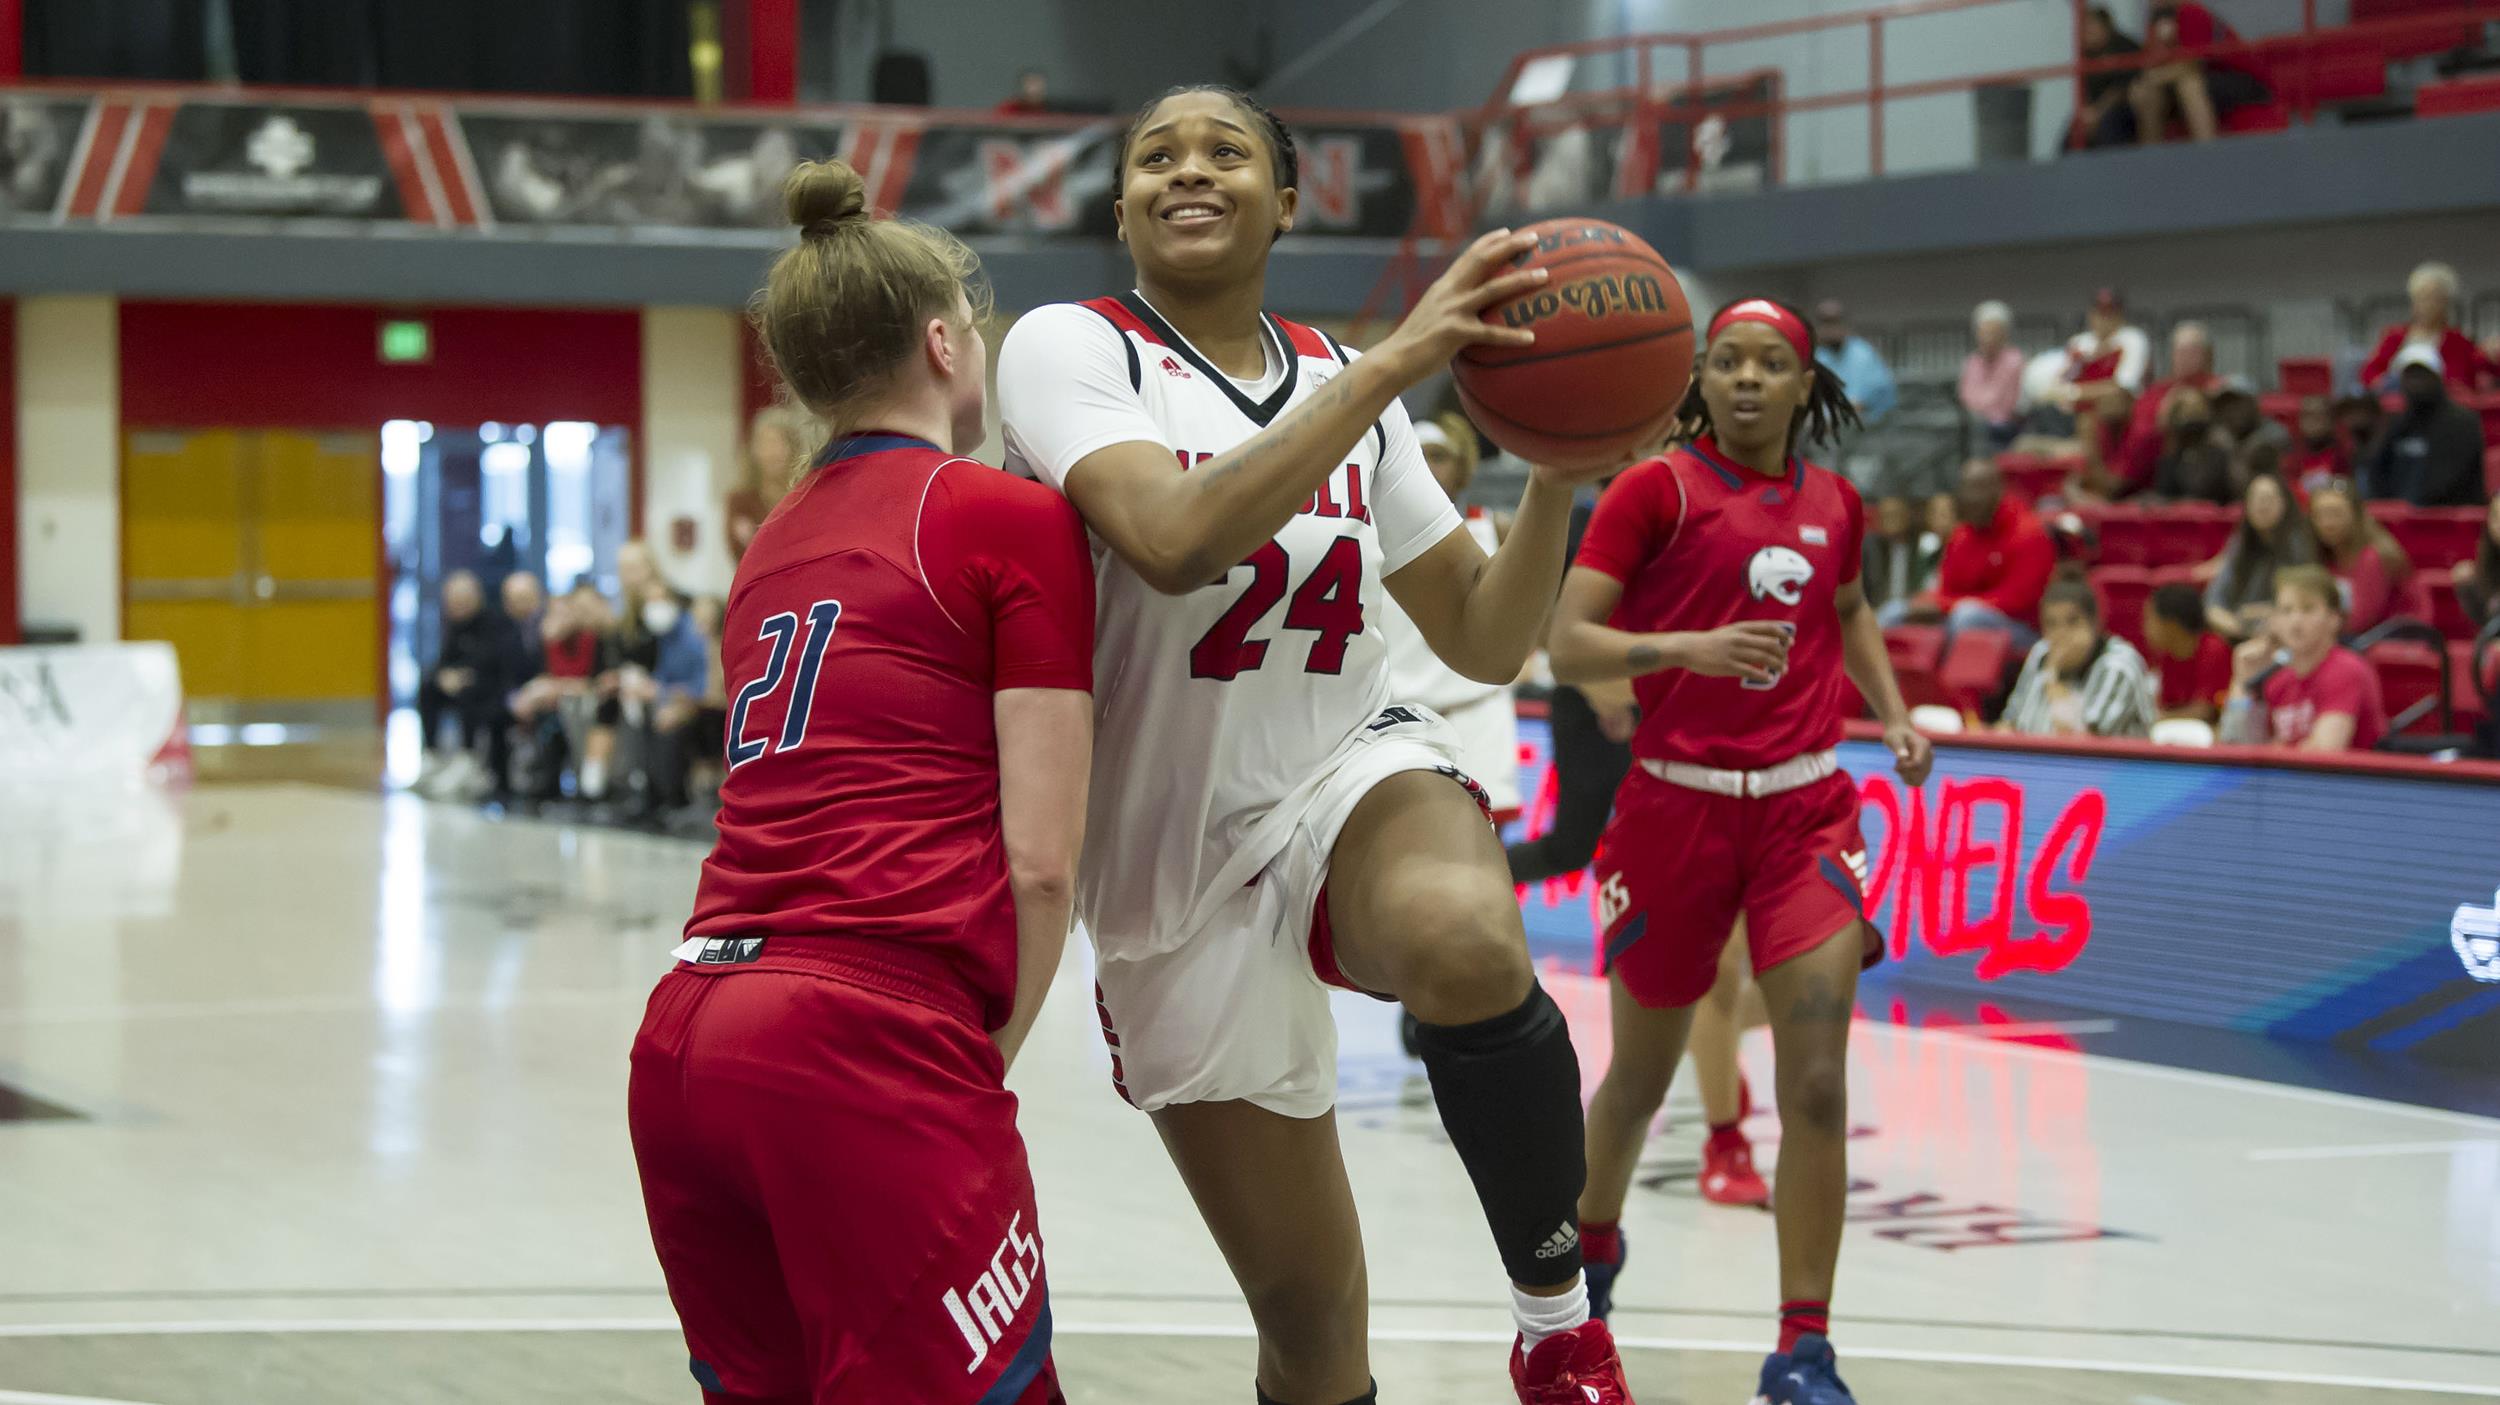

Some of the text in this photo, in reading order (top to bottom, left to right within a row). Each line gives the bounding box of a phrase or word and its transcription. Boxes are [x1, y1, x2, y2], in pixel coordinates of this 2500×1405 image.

[1502, 272, 1668, 328] Wilson
[727, 599, 841, 772] 21
[1190, 535, 1364, 681] 24
[942, 1209, 1039, 1375] JAGS
